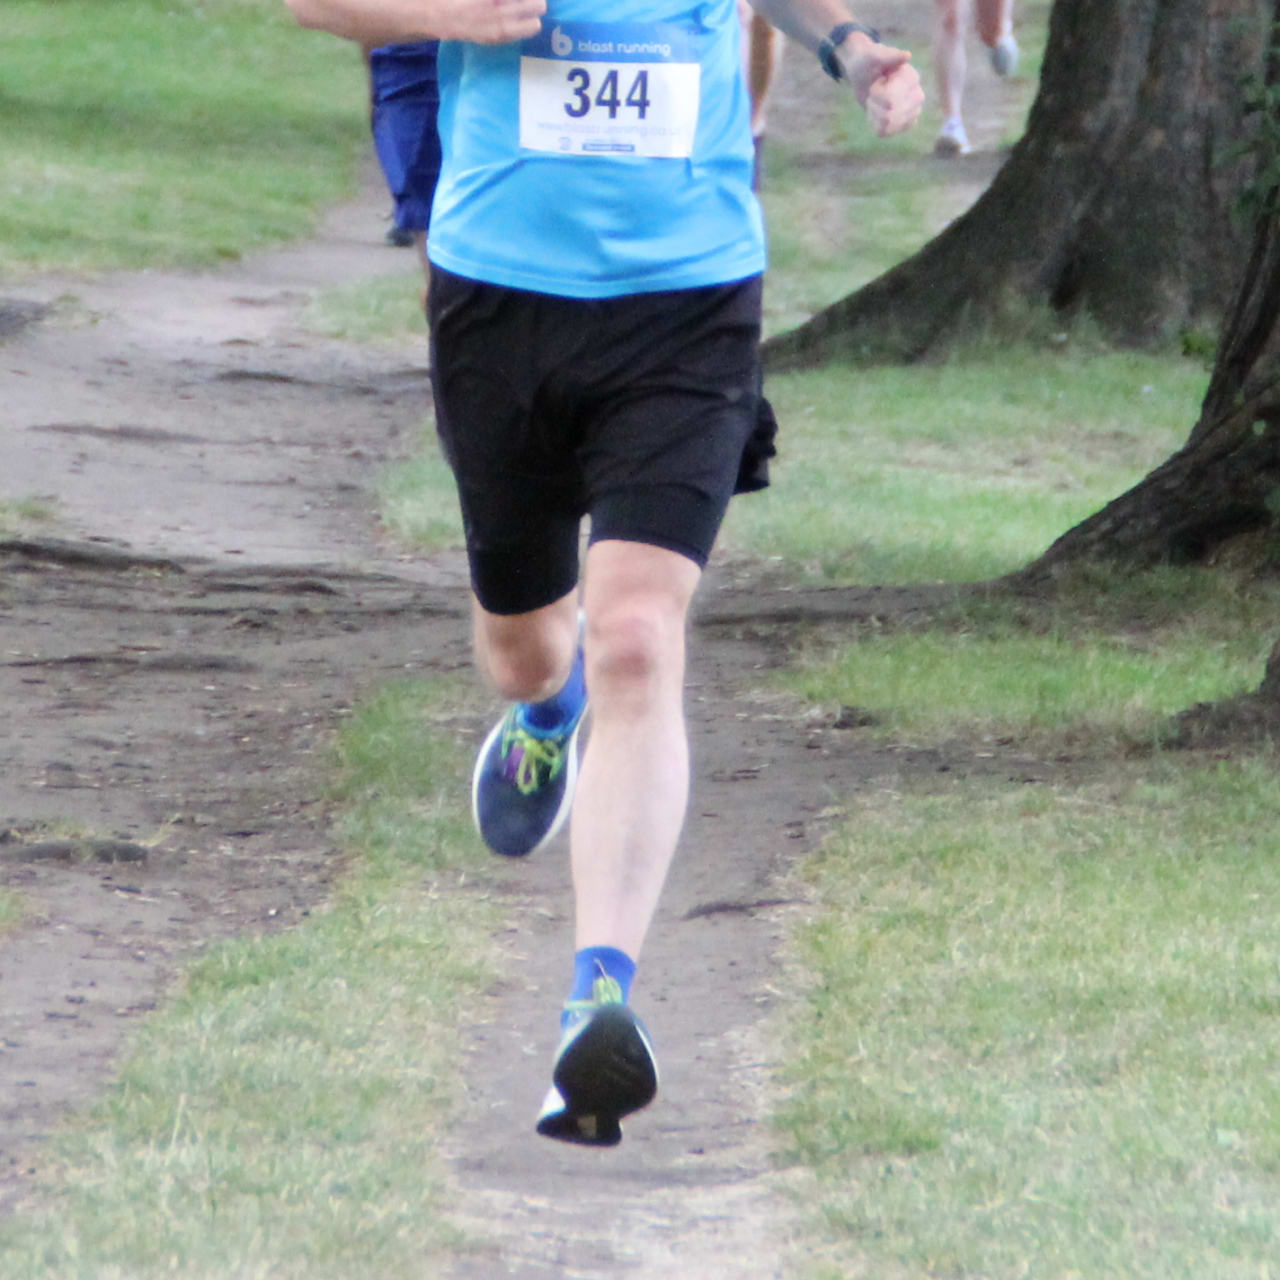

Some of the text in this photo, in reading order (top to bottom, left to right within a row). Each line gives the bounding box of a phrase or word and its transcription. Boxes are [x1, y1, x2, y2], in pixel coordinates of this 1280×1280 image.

[578, 40, 614, 53] blast
[617, 42, 671, 57] running
[564, 67, 650, 119] 344
